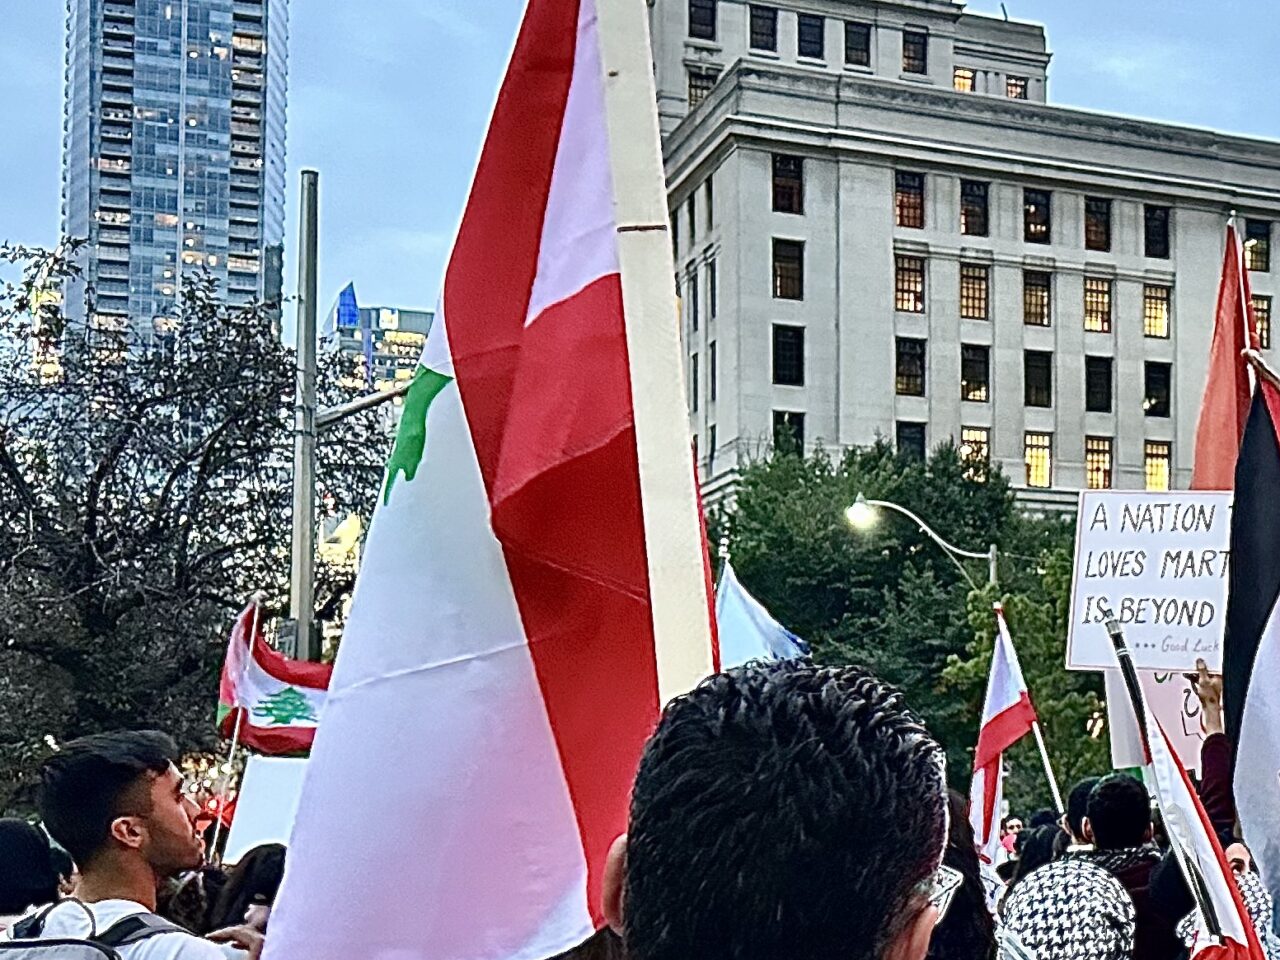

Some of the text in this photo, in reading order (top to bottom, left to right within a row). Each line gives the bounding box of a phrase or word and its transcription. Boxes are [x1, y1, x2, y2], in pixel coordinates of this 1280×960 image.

[1090, 502, 1216, 533] A NATION
[1084, 549, 1231, 579] LOVES MART
[1081, 596, 1216, 628] IS BEYOND
[1161, 634, 1189, 653] Good
[1192, 637, 1220, 653] Luck
